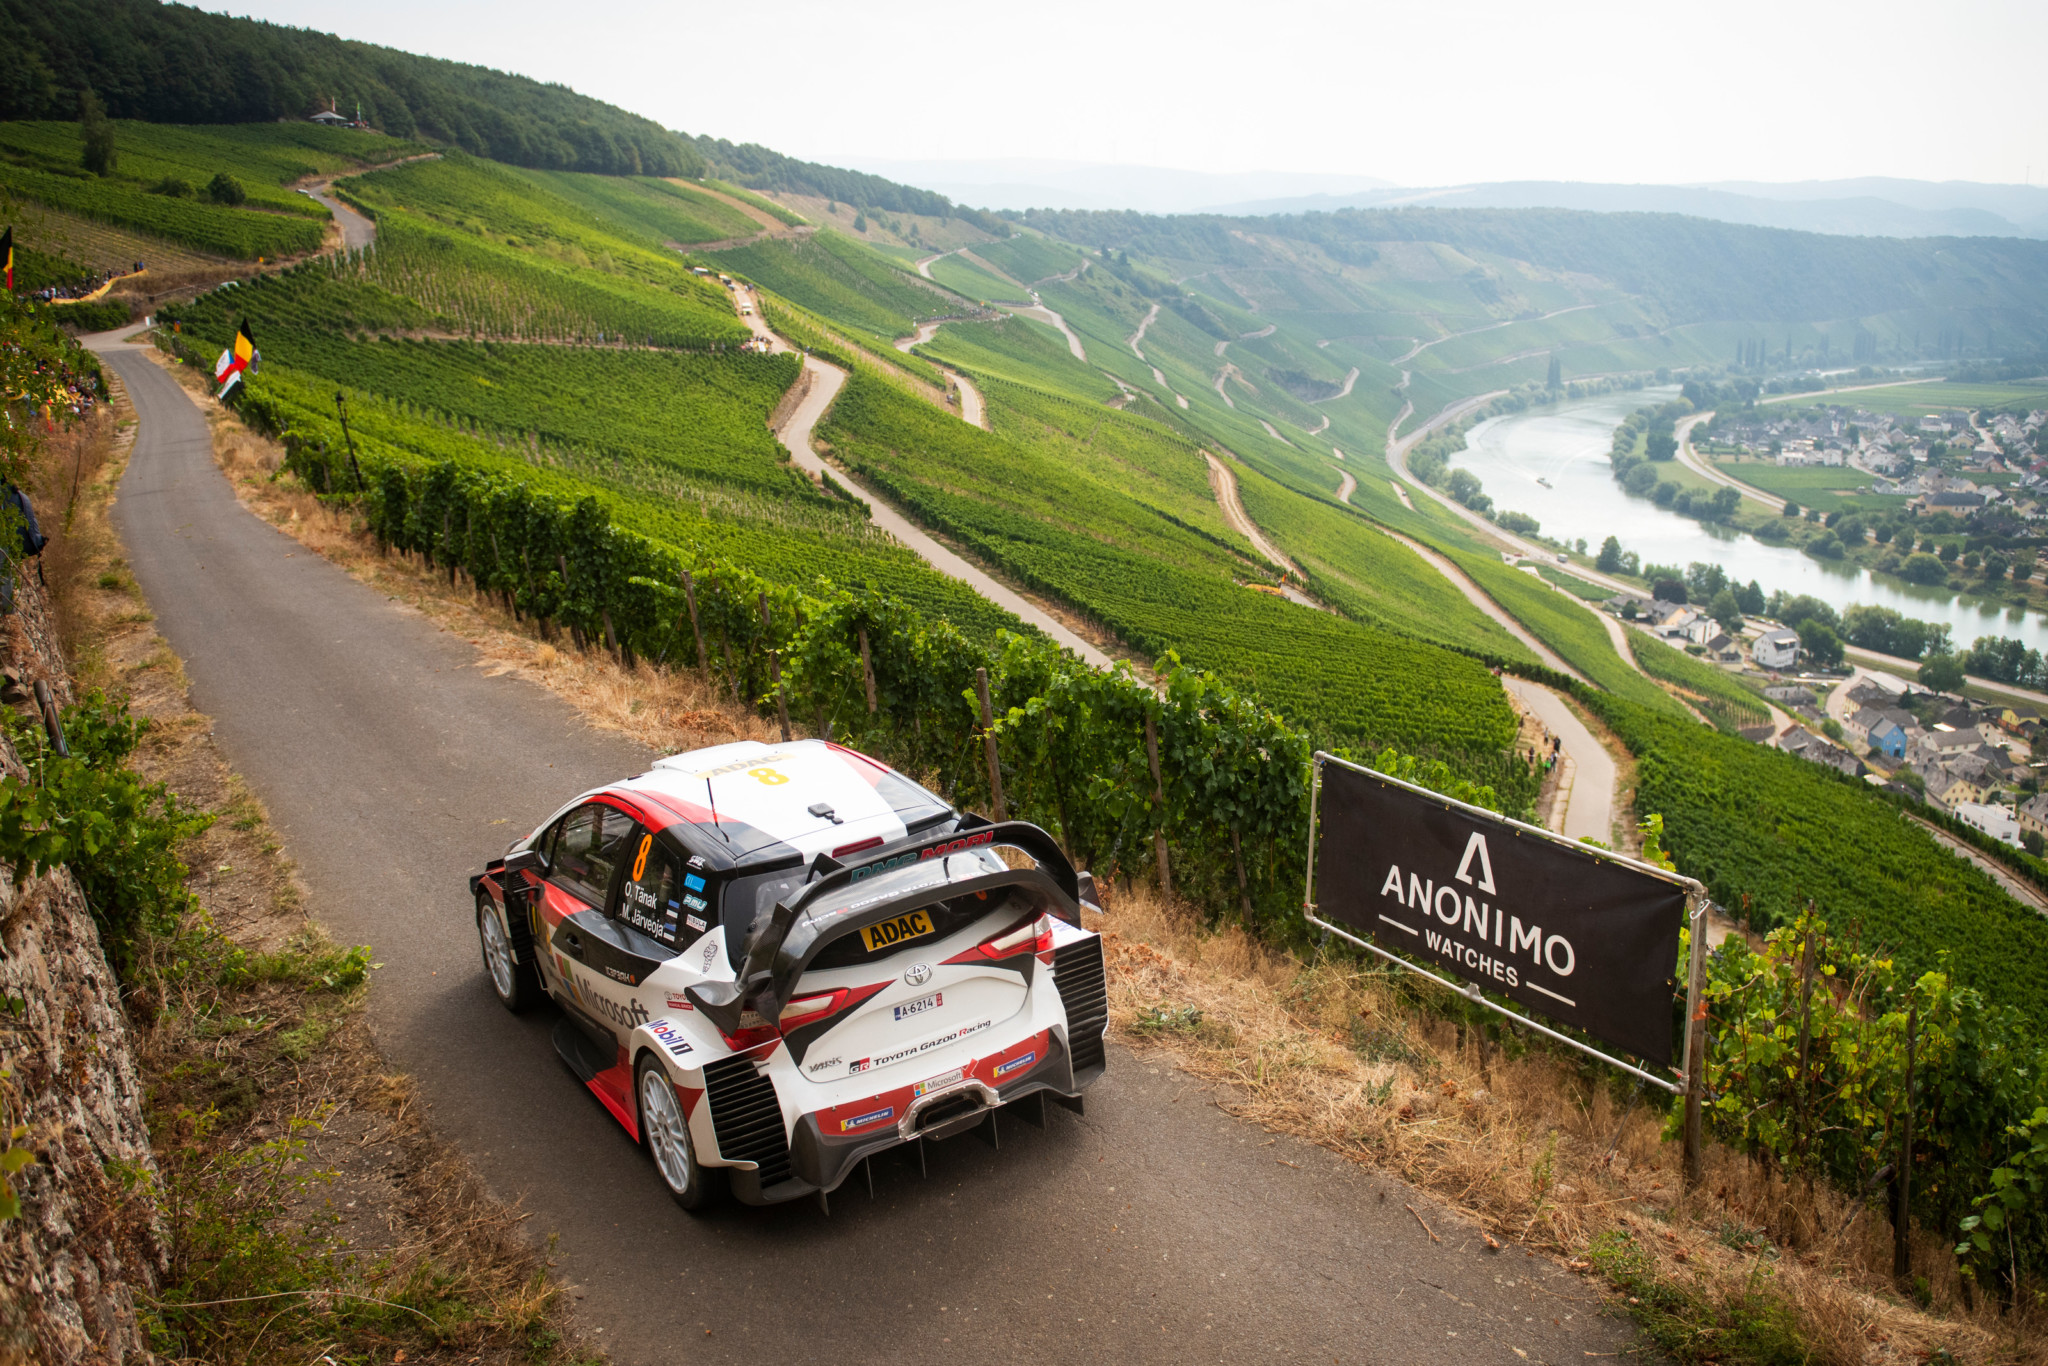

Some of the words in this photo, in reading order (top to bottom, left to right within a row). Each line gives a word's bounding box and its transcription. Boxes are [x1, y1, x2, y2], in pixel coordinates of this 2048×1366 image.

[711, 755, 782, 776] ADAC
[747, 768, 790, 785] 8
[632, 834, 652, 882] 8
[920, 831, 994, 861] MORI
[624, 881, 633, 898] O.
[635, 885, 657, 909] Tänak
[621, 902, 630, 920] M.
[631, 909, 664, 938] Järveoja
[871, 913, 927, 948] ADAC
[1381, 865, 1575, 976] ANONIMO
[1426, 929, 1518, 987] WATCHES
[575, 974, 650, 1029] Microsoft
[646, 1019, 685, 1046] Mobil
[873, 1047, 918, 1066] TOYOTA
[920, 1033, 957, 1051] GAZOO
[959, 1019, 992, 1037] Racing
[1005, 1055, 1033, 1071] MICHELIN
[927, 1071, 962, 1090] Microsoft
[856, 1110, 890, 1124] MICHELIN
